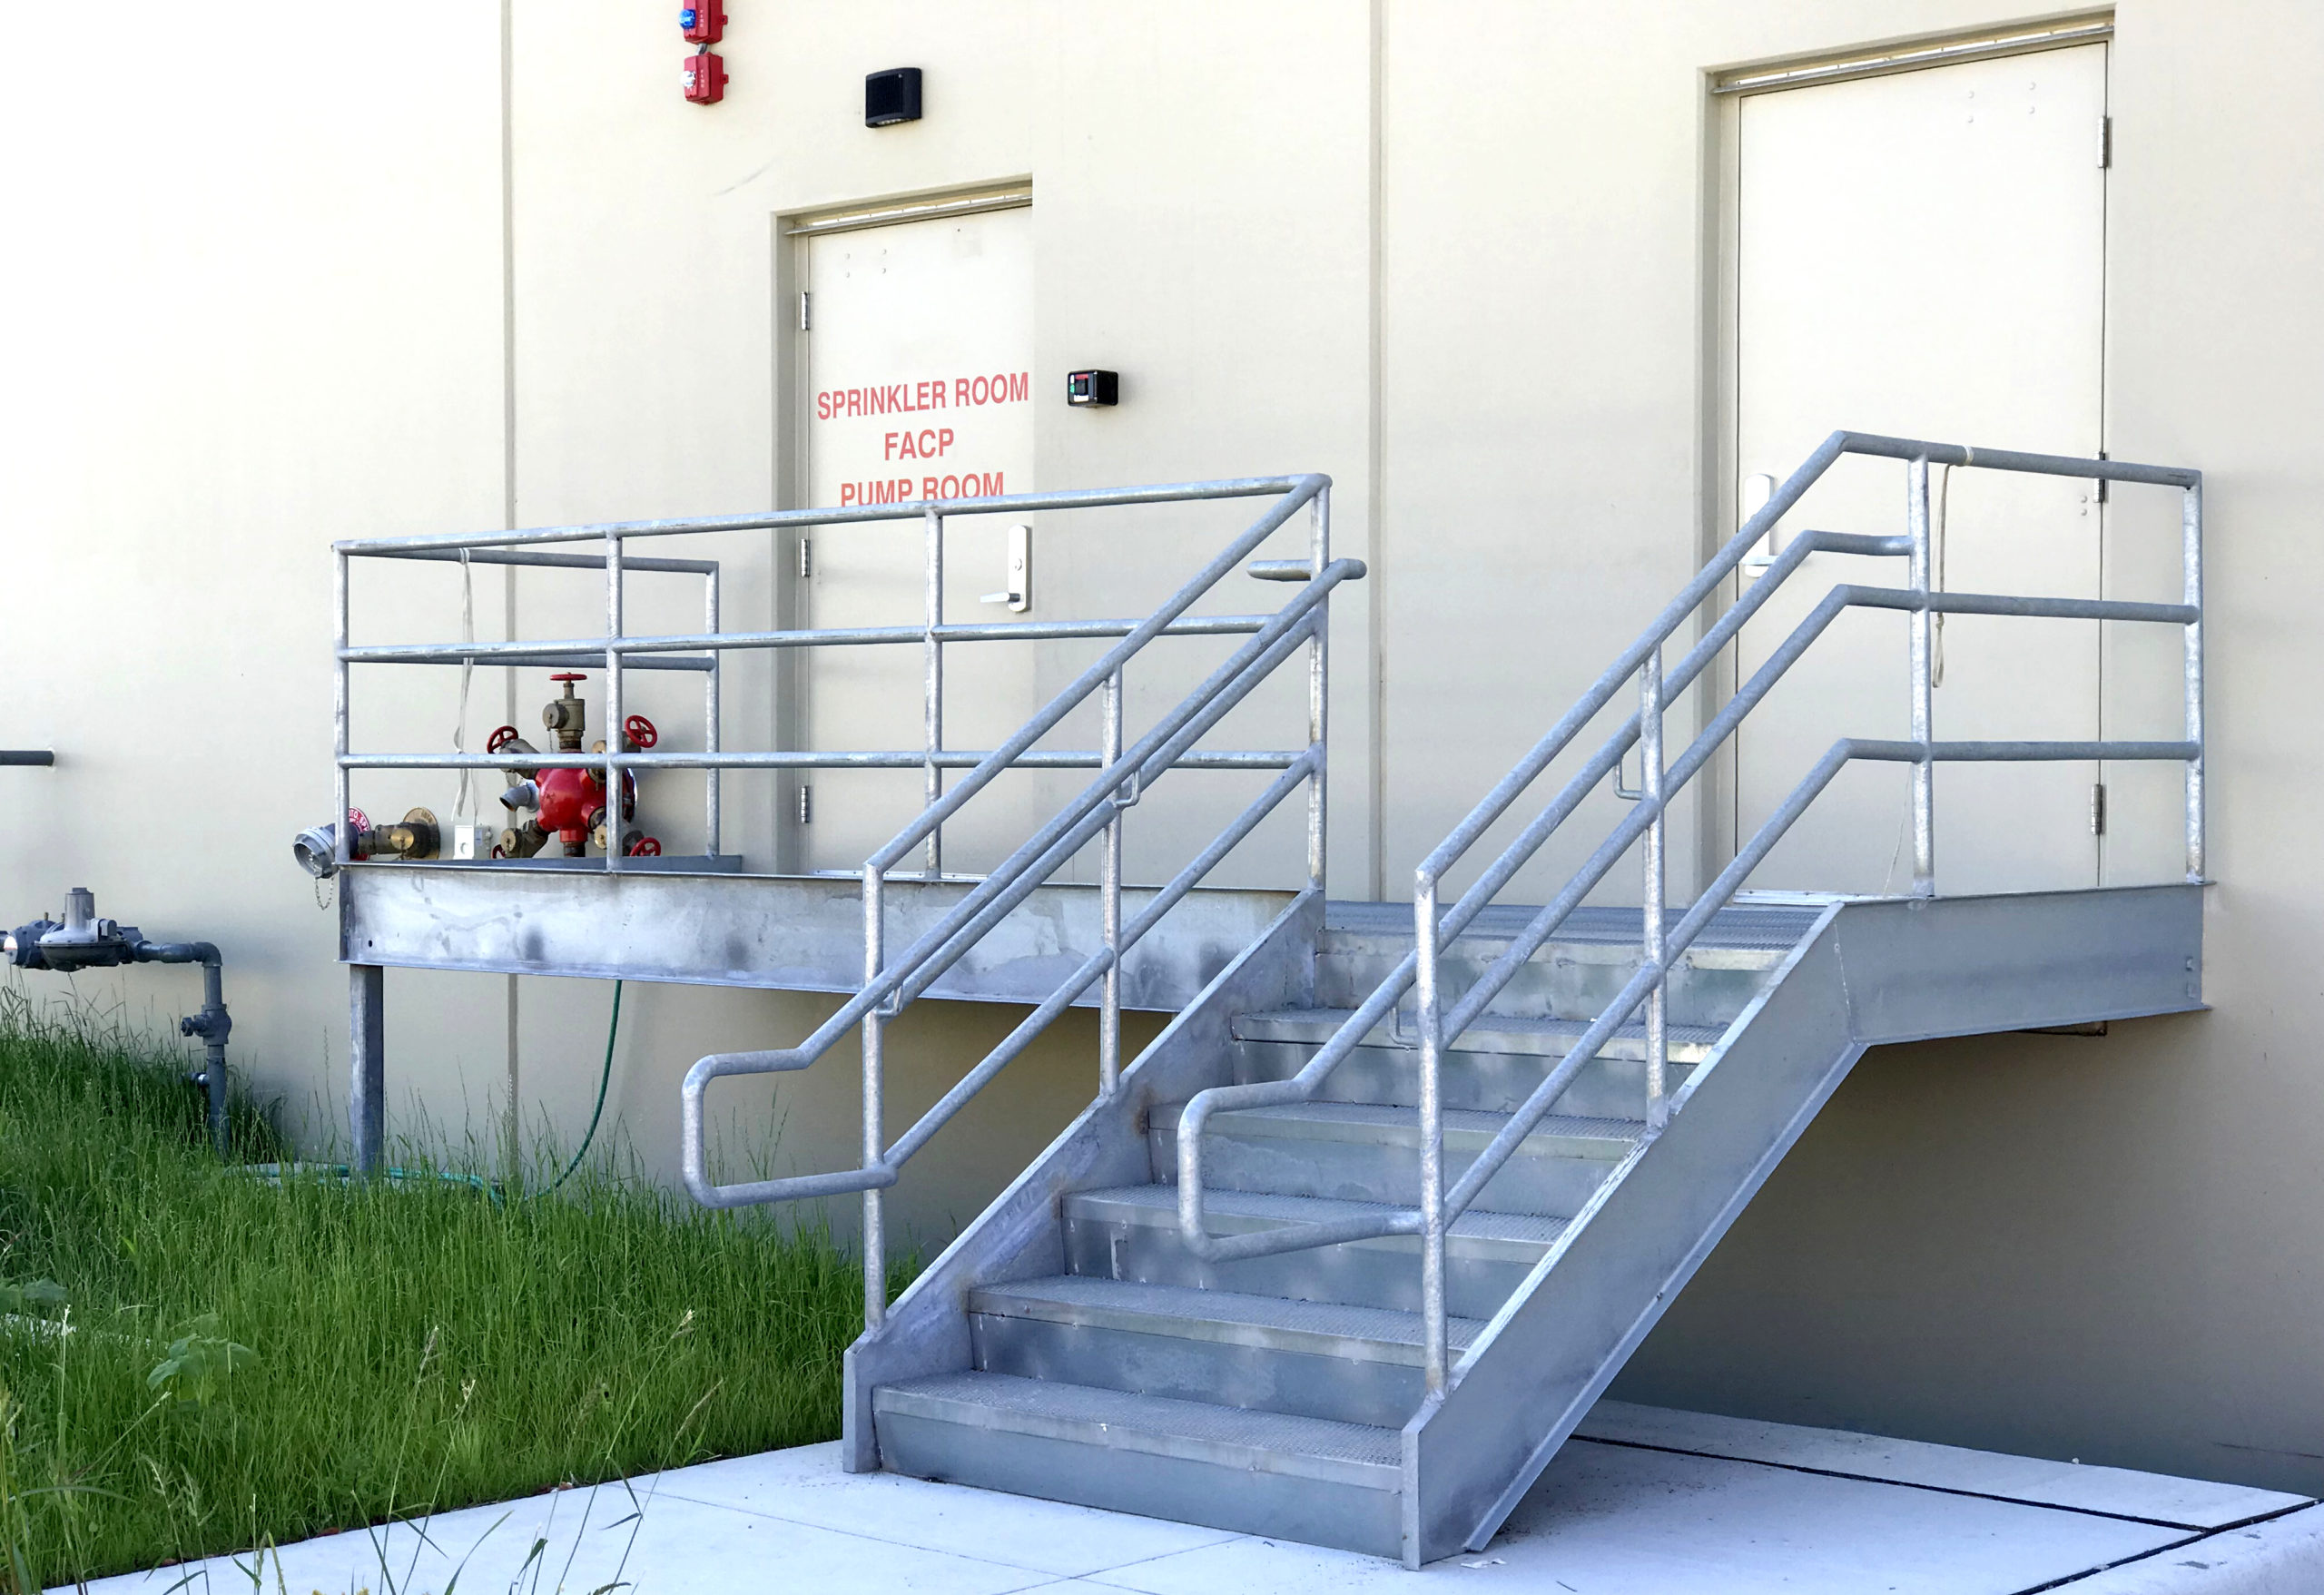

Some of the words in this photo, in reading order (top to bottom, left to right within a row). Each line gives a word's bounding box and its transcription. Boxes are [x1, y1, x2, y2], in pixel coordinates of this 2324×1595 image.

[817, 380, 946, 420] SPRINKLER
[955, 371, 1029, 407] ROOM
[884, 428, 954, 460] FACP
[841, 478, 913, 507] PUMP
[922, 471, 1004, 500] ROOM
